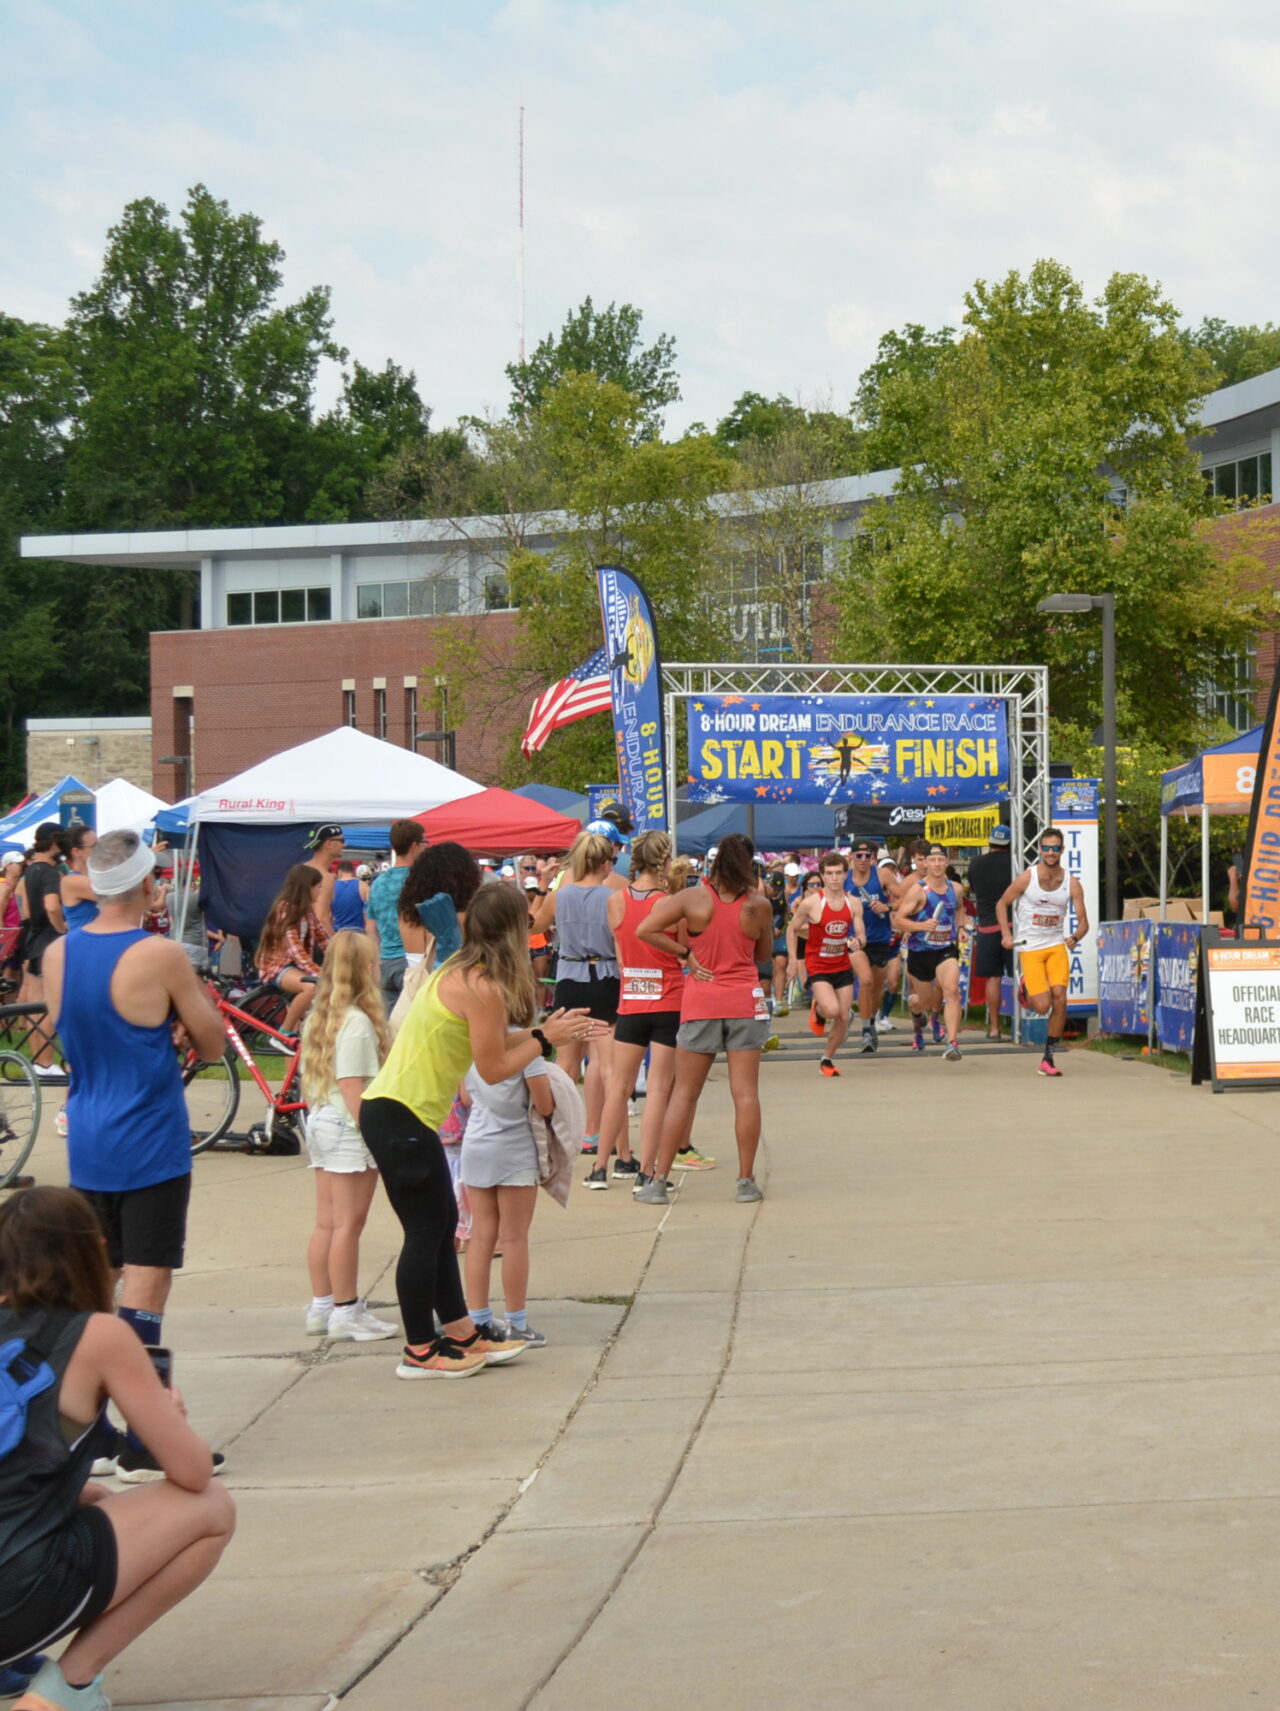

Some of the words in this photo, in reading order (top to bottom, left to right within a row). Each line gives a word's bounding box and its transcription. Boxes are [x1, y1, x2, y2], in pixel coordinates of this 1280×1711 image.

[700, 714, 755, 732] 8-HOUR
[759, 713, 812, 732] DREAM
[816, 713, 940, 732] ENDURANCE
[942, 713, 997, 732] RACE
[623, 701, 649, 836] ENDURAN
[640, 721, 664, 819] 8-HOUR
[700, 738, 806, 780] START
[896, 738, 999, 778] FINISH
[219, 799, 252, 808] Rural
[256, 799, 285, 811] King
[1244, 1006, 1276, 1023] RACE
